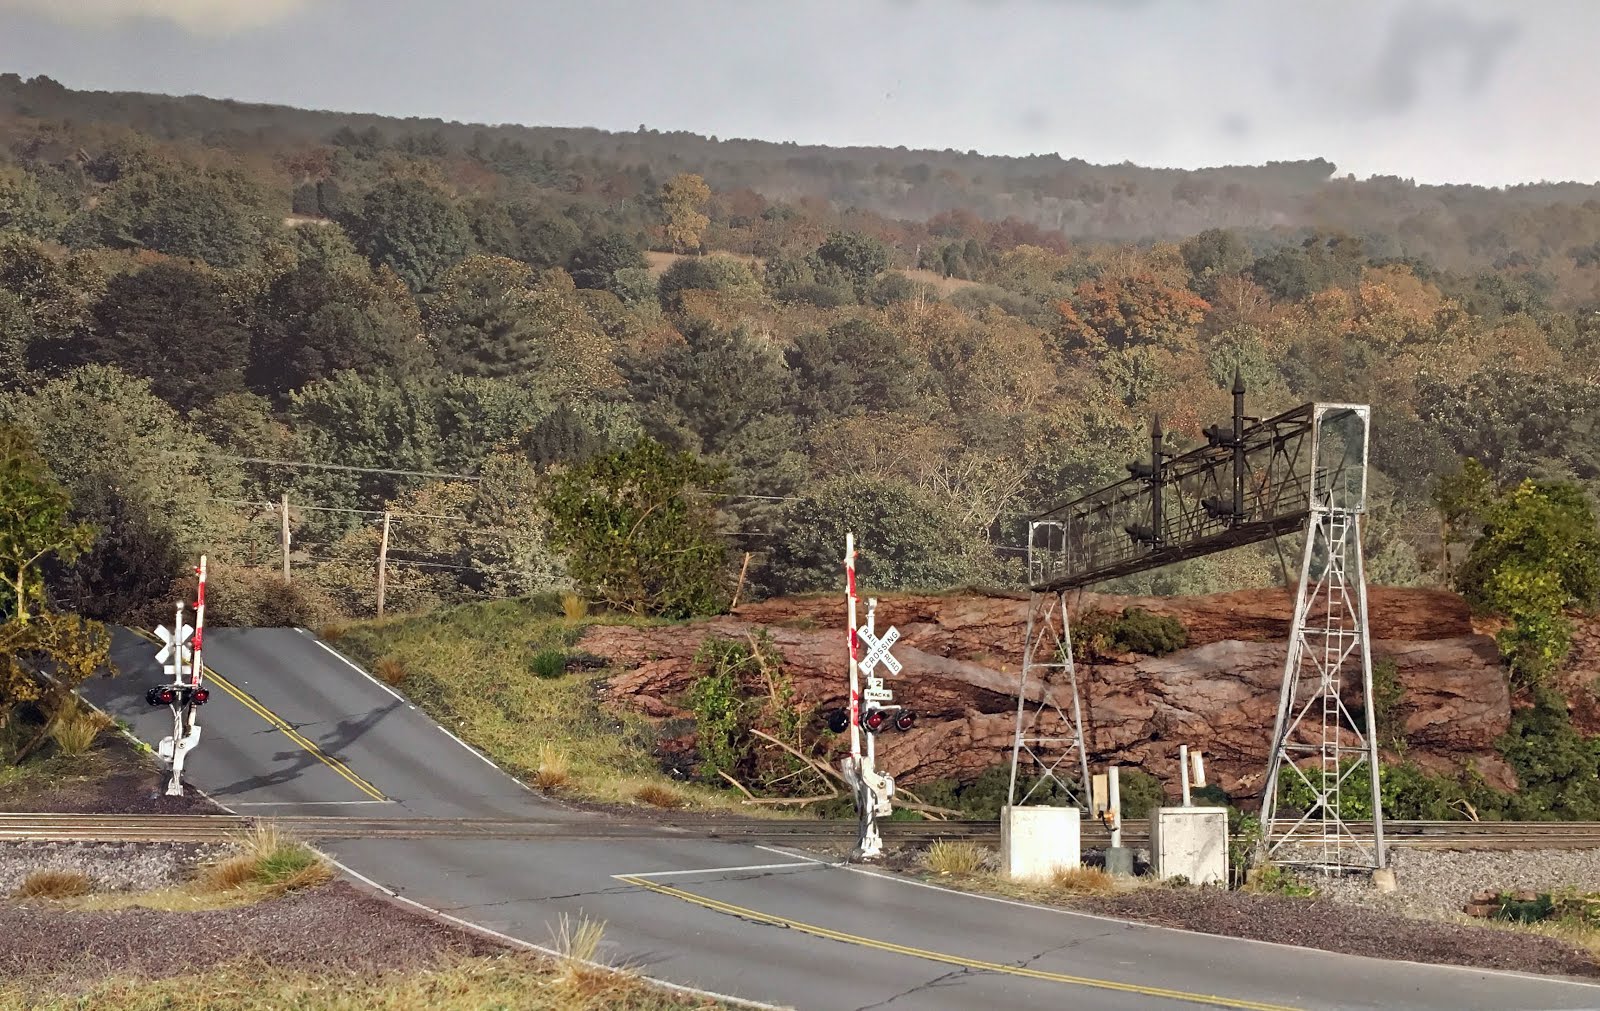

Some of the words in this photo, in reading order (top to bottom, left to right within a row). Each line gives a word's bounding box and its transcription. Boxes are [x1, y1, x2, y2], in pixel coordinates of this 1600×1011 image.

[863, 628, 877, 646] RAIL
[884, 653, 899, 672] ROAD
[864, 631, 898, 668] CROSSING
